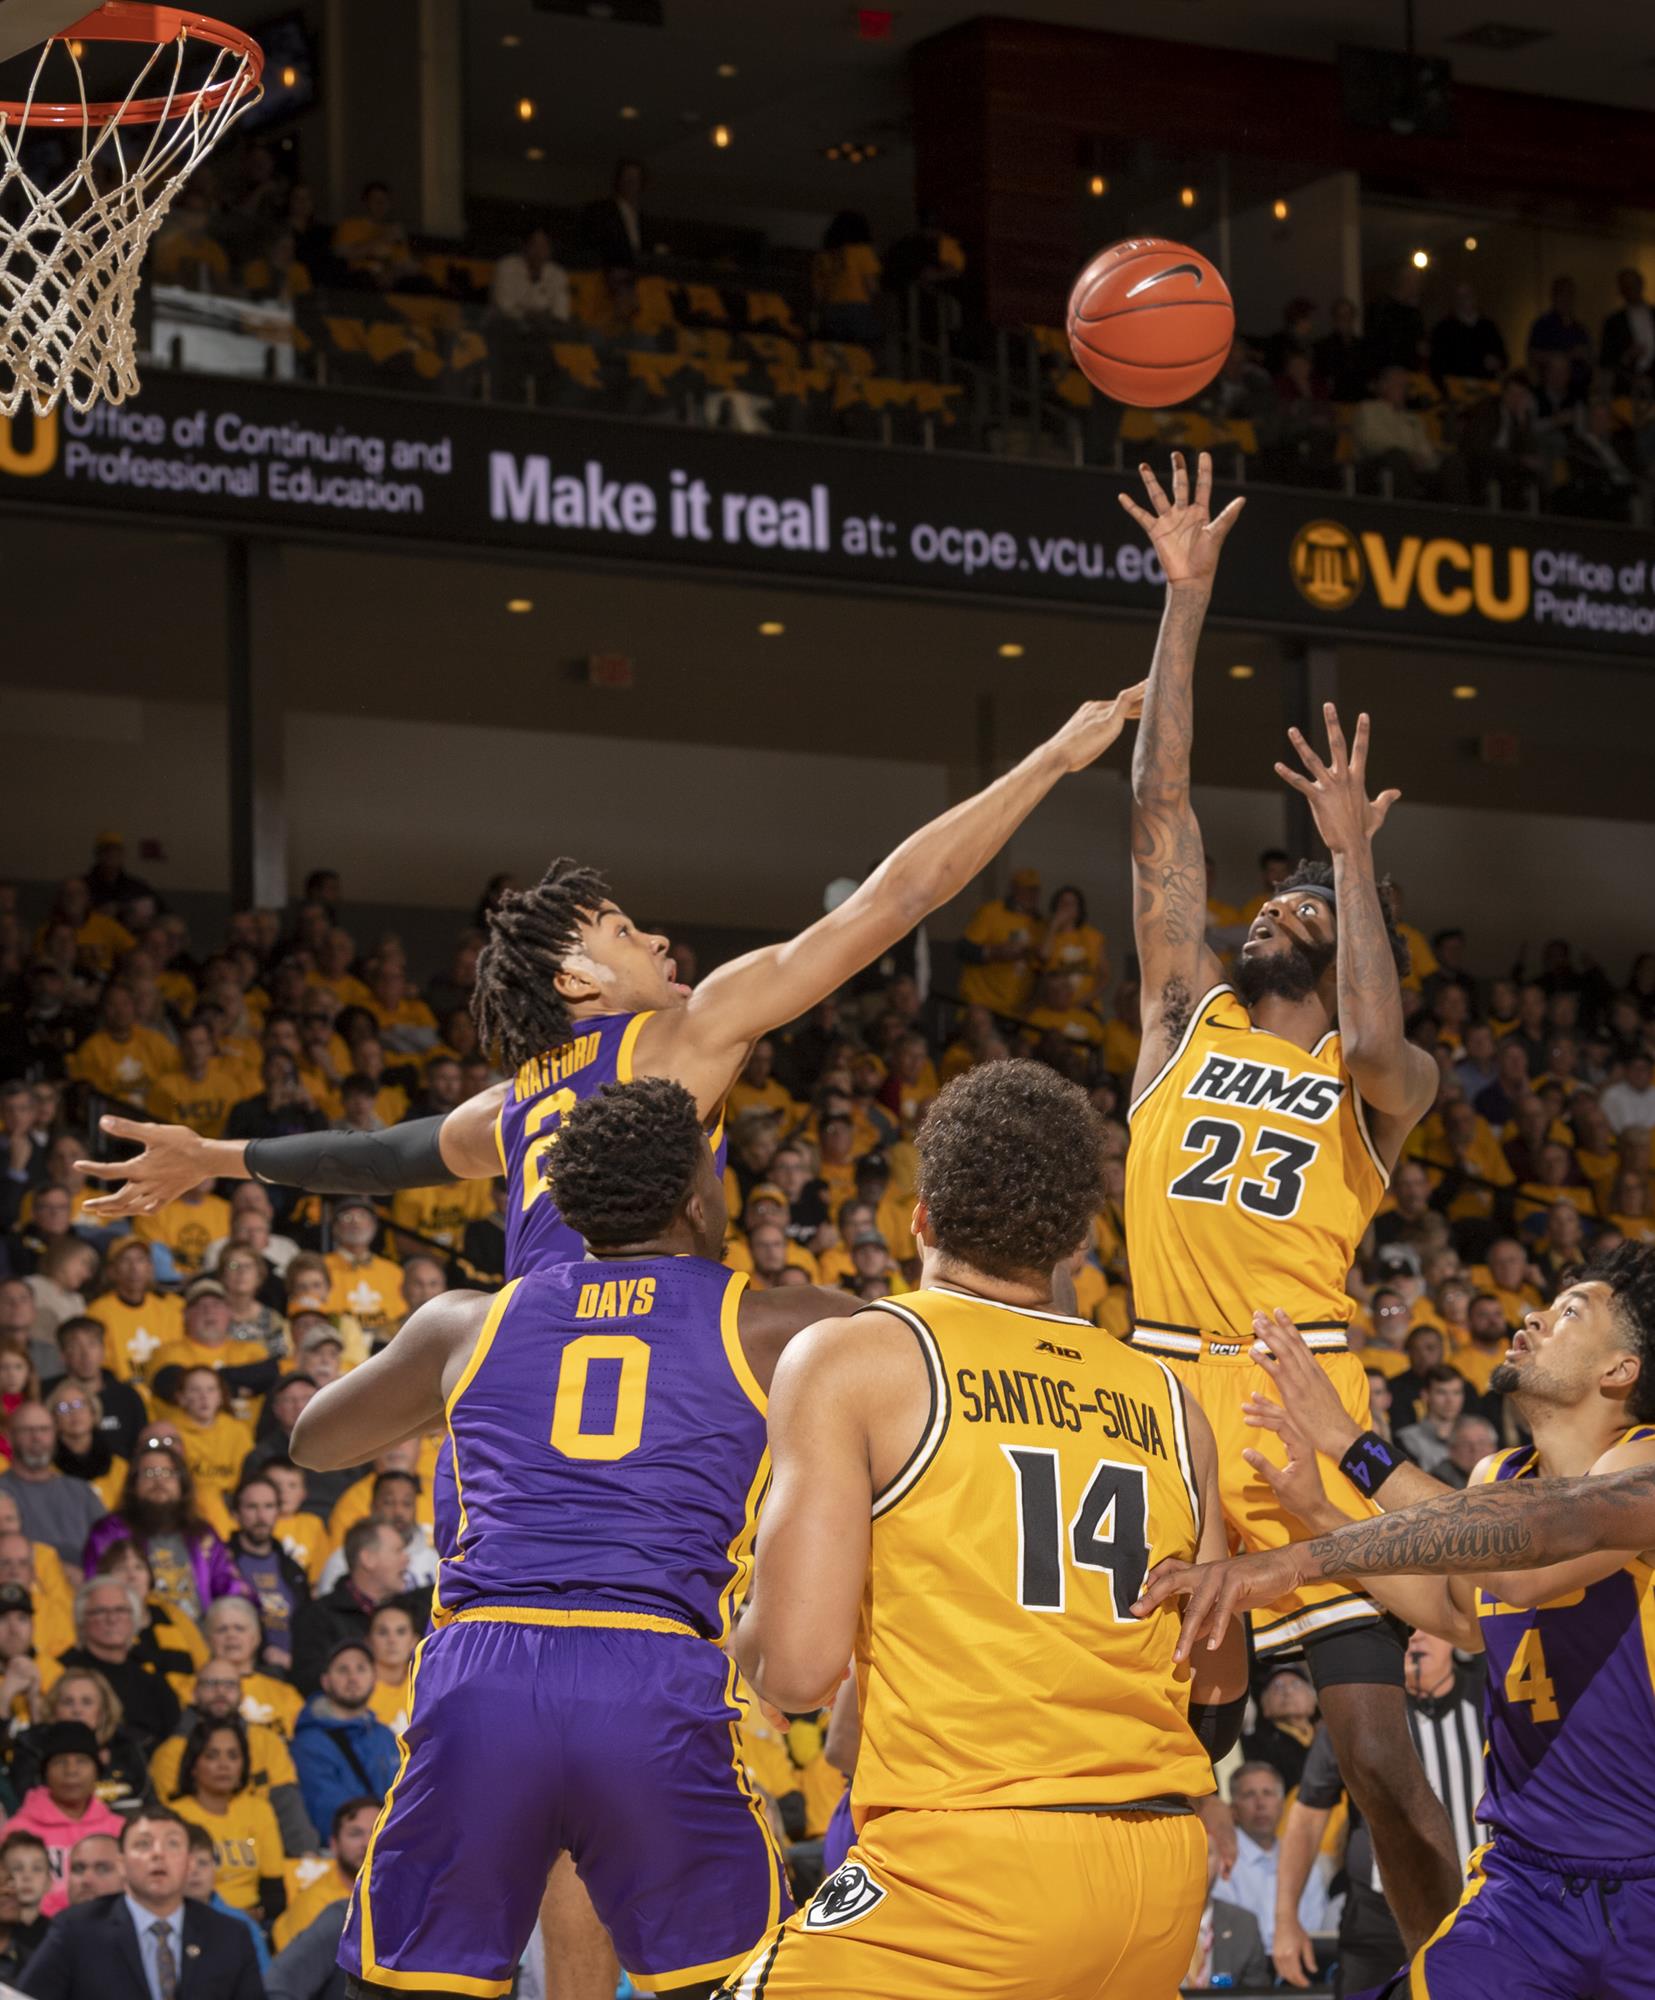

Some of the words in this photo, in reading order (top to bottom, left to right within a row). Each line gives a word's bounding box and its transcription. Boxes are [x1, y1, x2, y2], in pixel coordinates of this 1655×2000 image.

[64, 400, 166, 445] Office
[173, 410, 207, 448] of
[215, 412, 385, 475] Continuing
[391, 437, 452, 475] and
[65, 441, 260, 498] Professional
[268, 461, 424, 514] Education
[489, 450, 658, 536] Make
[669, 468, 713, 541] it
[722, 483, 831, 552] real
[841, 514, 897, 558] at:
[1360, 531, 1530, 622] VCU
[1532, 549, 1614, 593] Office
[1617, 561, 1646, 595] of
[1534, 588, 1655, 636] Professio
[1182, 1051, 1345, 1125] RAMS
[1166, 1115, 1320, 1221] 23
[575, 1277, 656, 1319] DAYS
[1209, 1341, 1241, 1356] VCU
[550, 1334, 651, 1461] 0
[956, 1368, 1168, 1461] SANTOS-SILVA
[999, 1443, 1153, 1623] 14
[1504, 1628, 1560, 1724] 4
